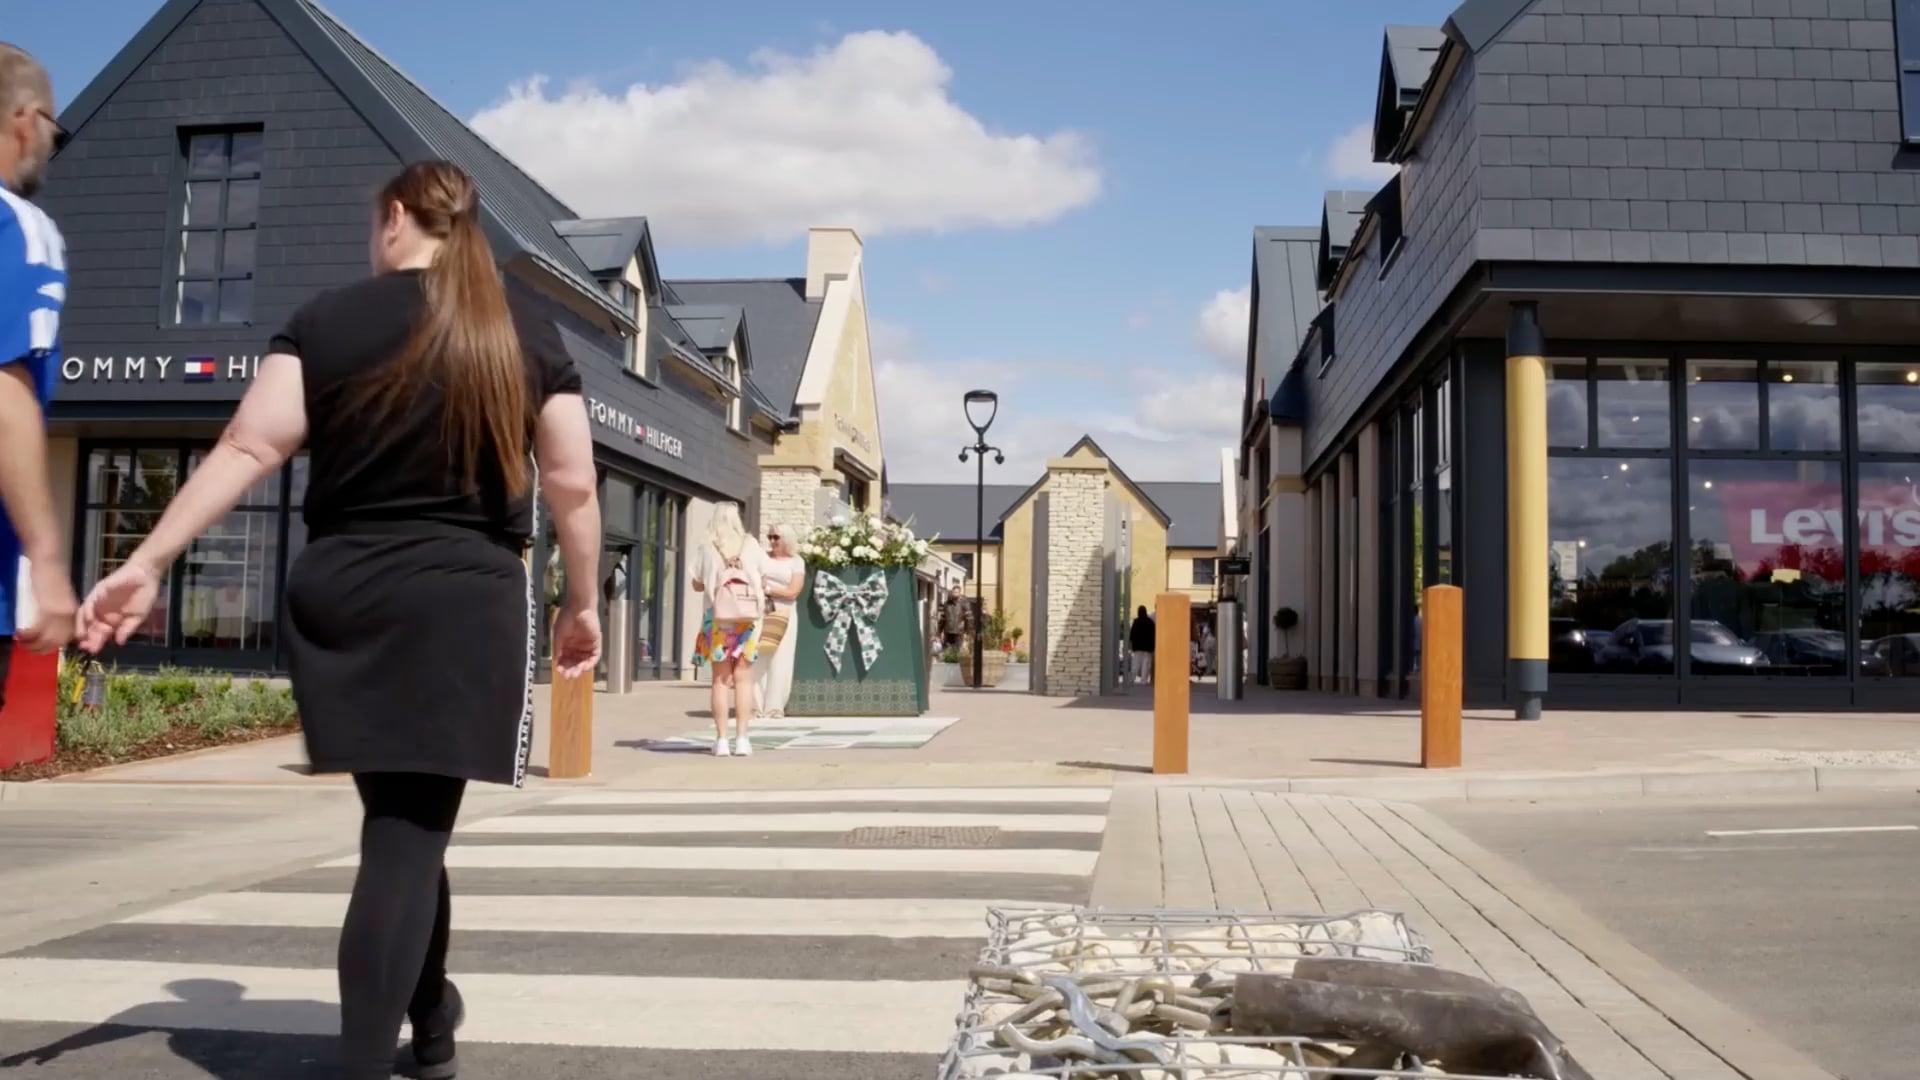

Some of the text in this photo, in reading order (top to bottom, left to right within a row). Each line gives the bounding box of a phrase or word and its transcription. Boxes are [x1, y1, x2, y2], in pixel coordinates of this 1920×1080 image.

[62, 356, 172, 380] OMMY
[589, 398, 683, 459] TOMMY HILFIGER
